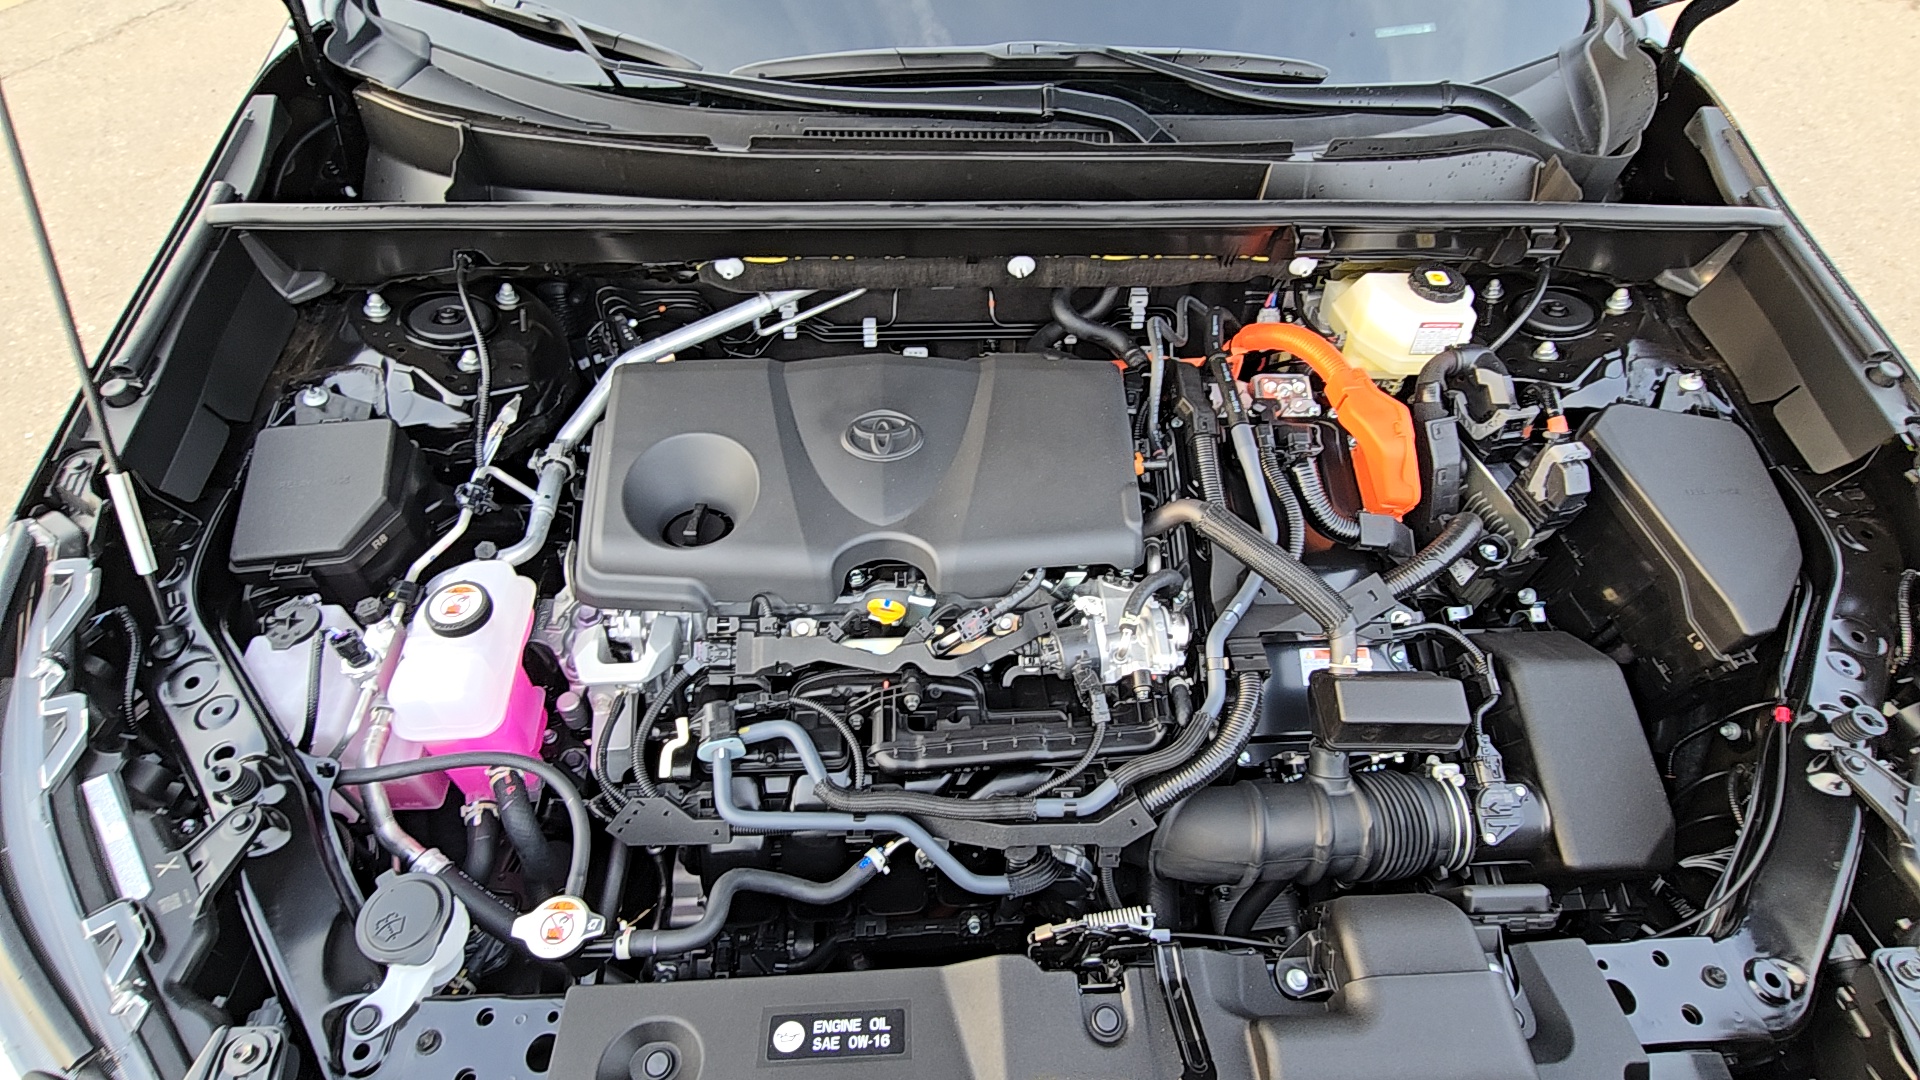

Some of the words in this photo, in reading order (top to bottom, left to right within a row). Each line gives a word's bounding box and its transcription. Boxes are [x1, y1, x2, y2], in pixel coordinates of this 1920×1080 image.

[371, 533, 389, 550] R8
[813, 1018, 862, 1034] ENGINE
[869, 1017, 891, 1031] OIL
[812, 1036, 840, 1051] SAE
[848, 1034, 891, 1049] 0W-16
